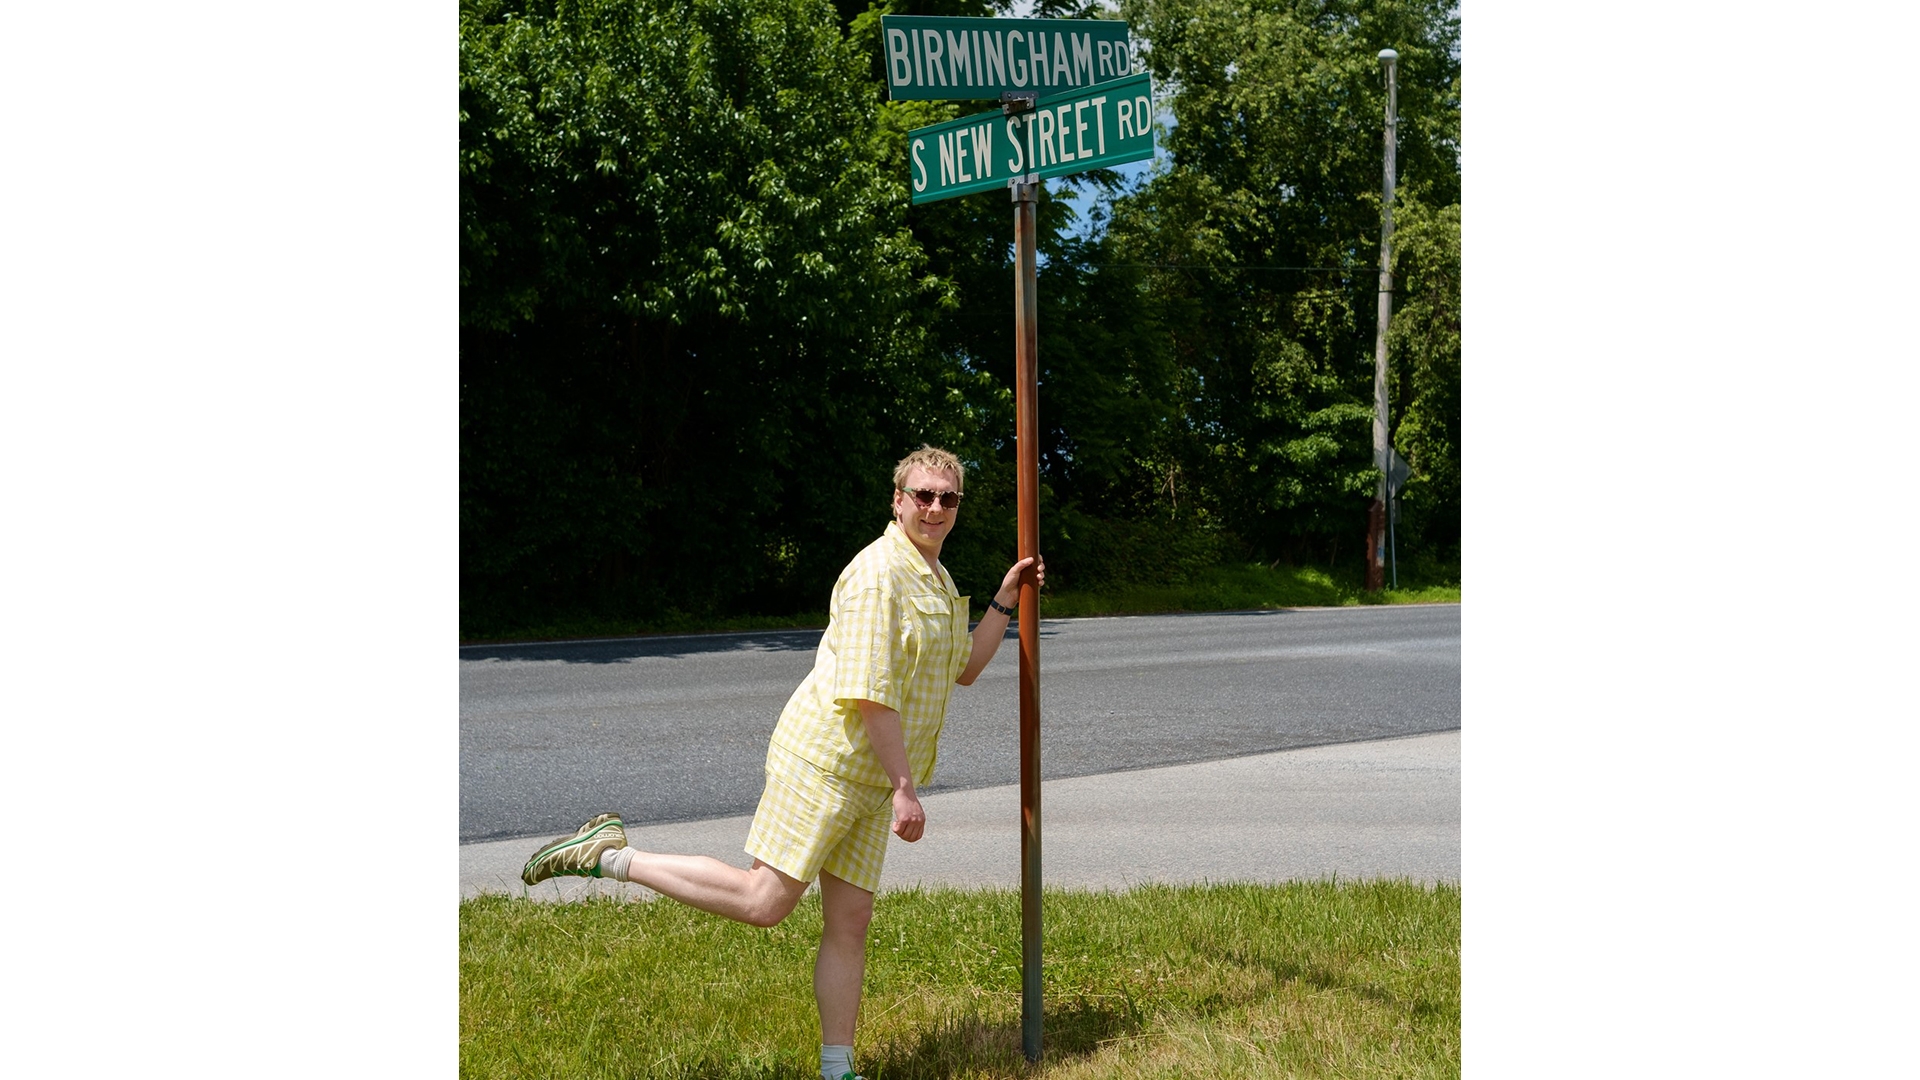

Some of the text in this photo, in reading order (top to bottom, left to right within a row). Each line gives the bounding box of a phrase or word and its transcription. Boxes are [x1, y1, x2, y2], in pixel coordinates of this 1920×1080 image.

[887, 28, 1131, 88] BIRMINGHAM RD
[912, 95, 1151, 192] S NEW STREET RD
